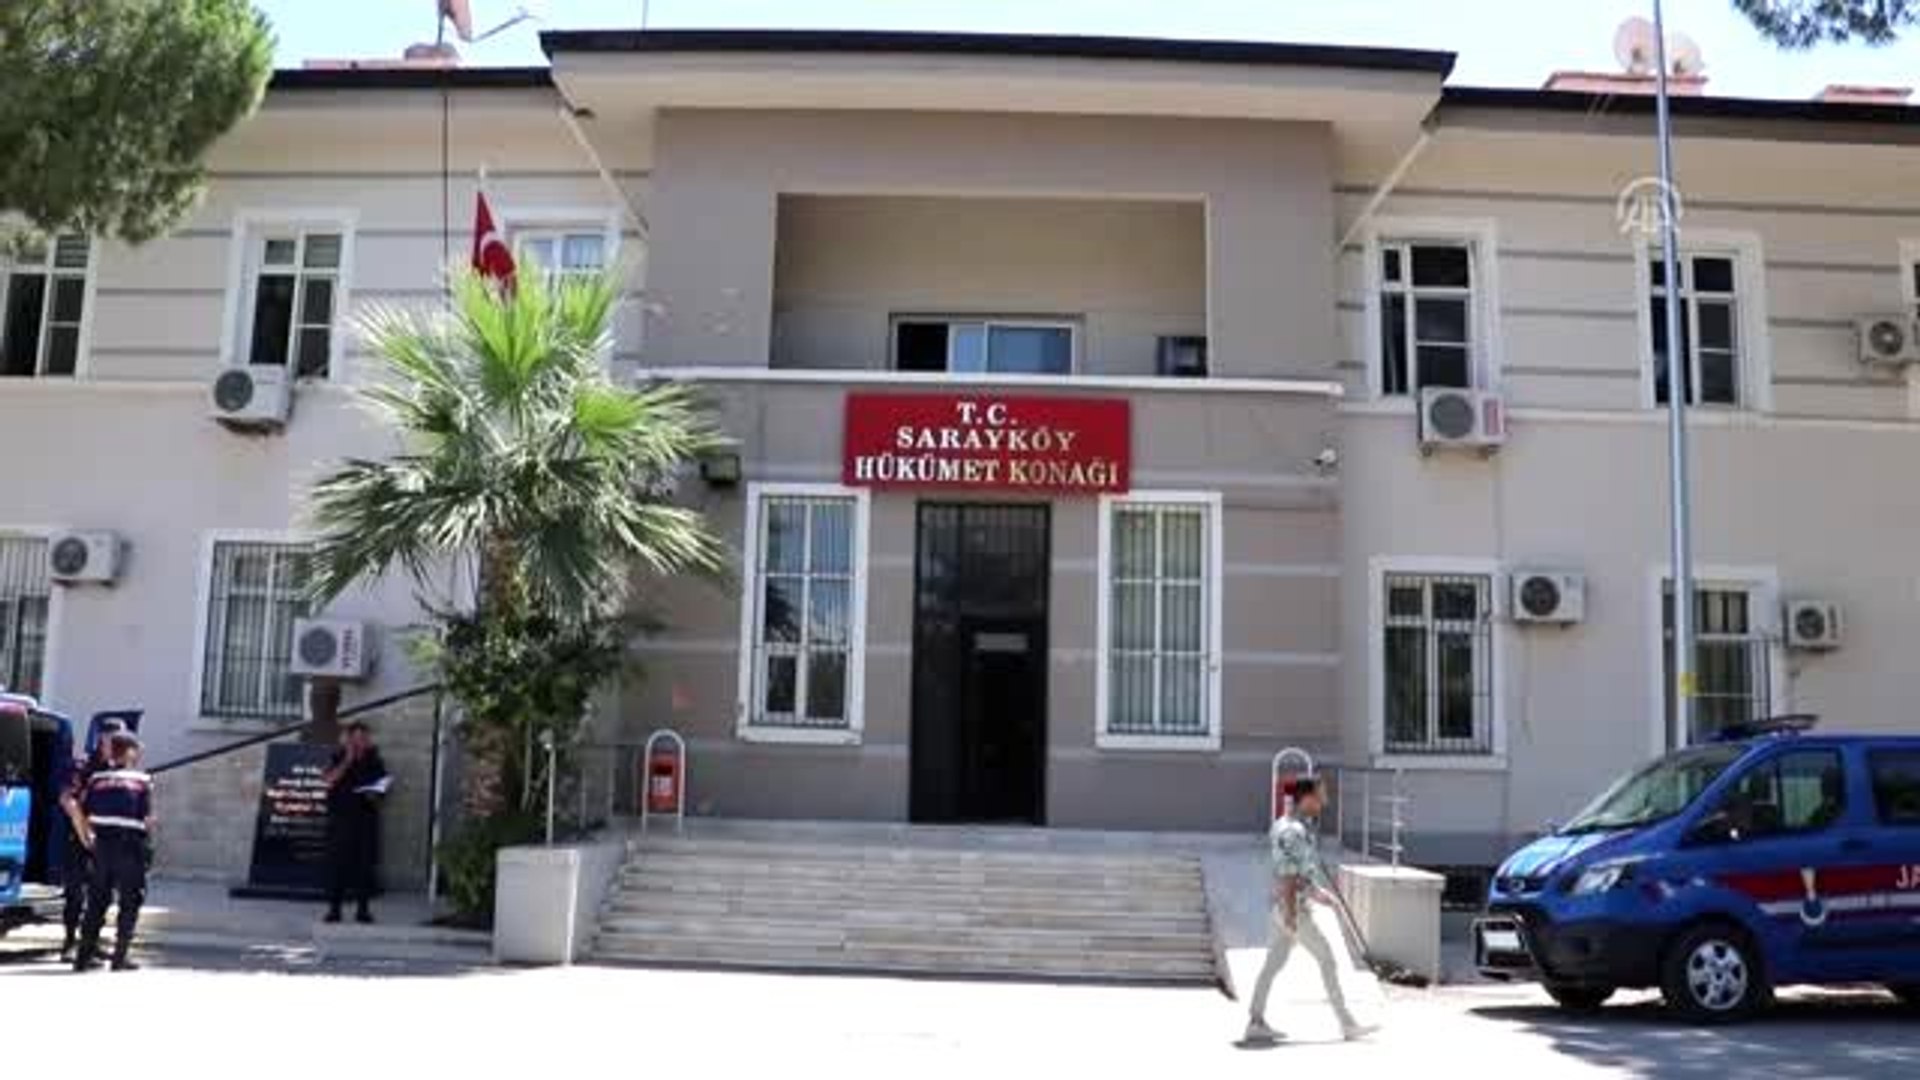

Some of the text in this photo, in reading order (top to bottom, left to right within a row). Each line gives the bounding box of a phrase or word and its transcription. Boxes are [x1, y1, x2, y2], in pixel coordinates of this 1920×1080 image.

[956, 401, 1019, 426] T.C.
[896, 426, 1076, 453] SARAYKÖY
[855, 451, 1118, 485] HÜKÜMET KONAĞI
